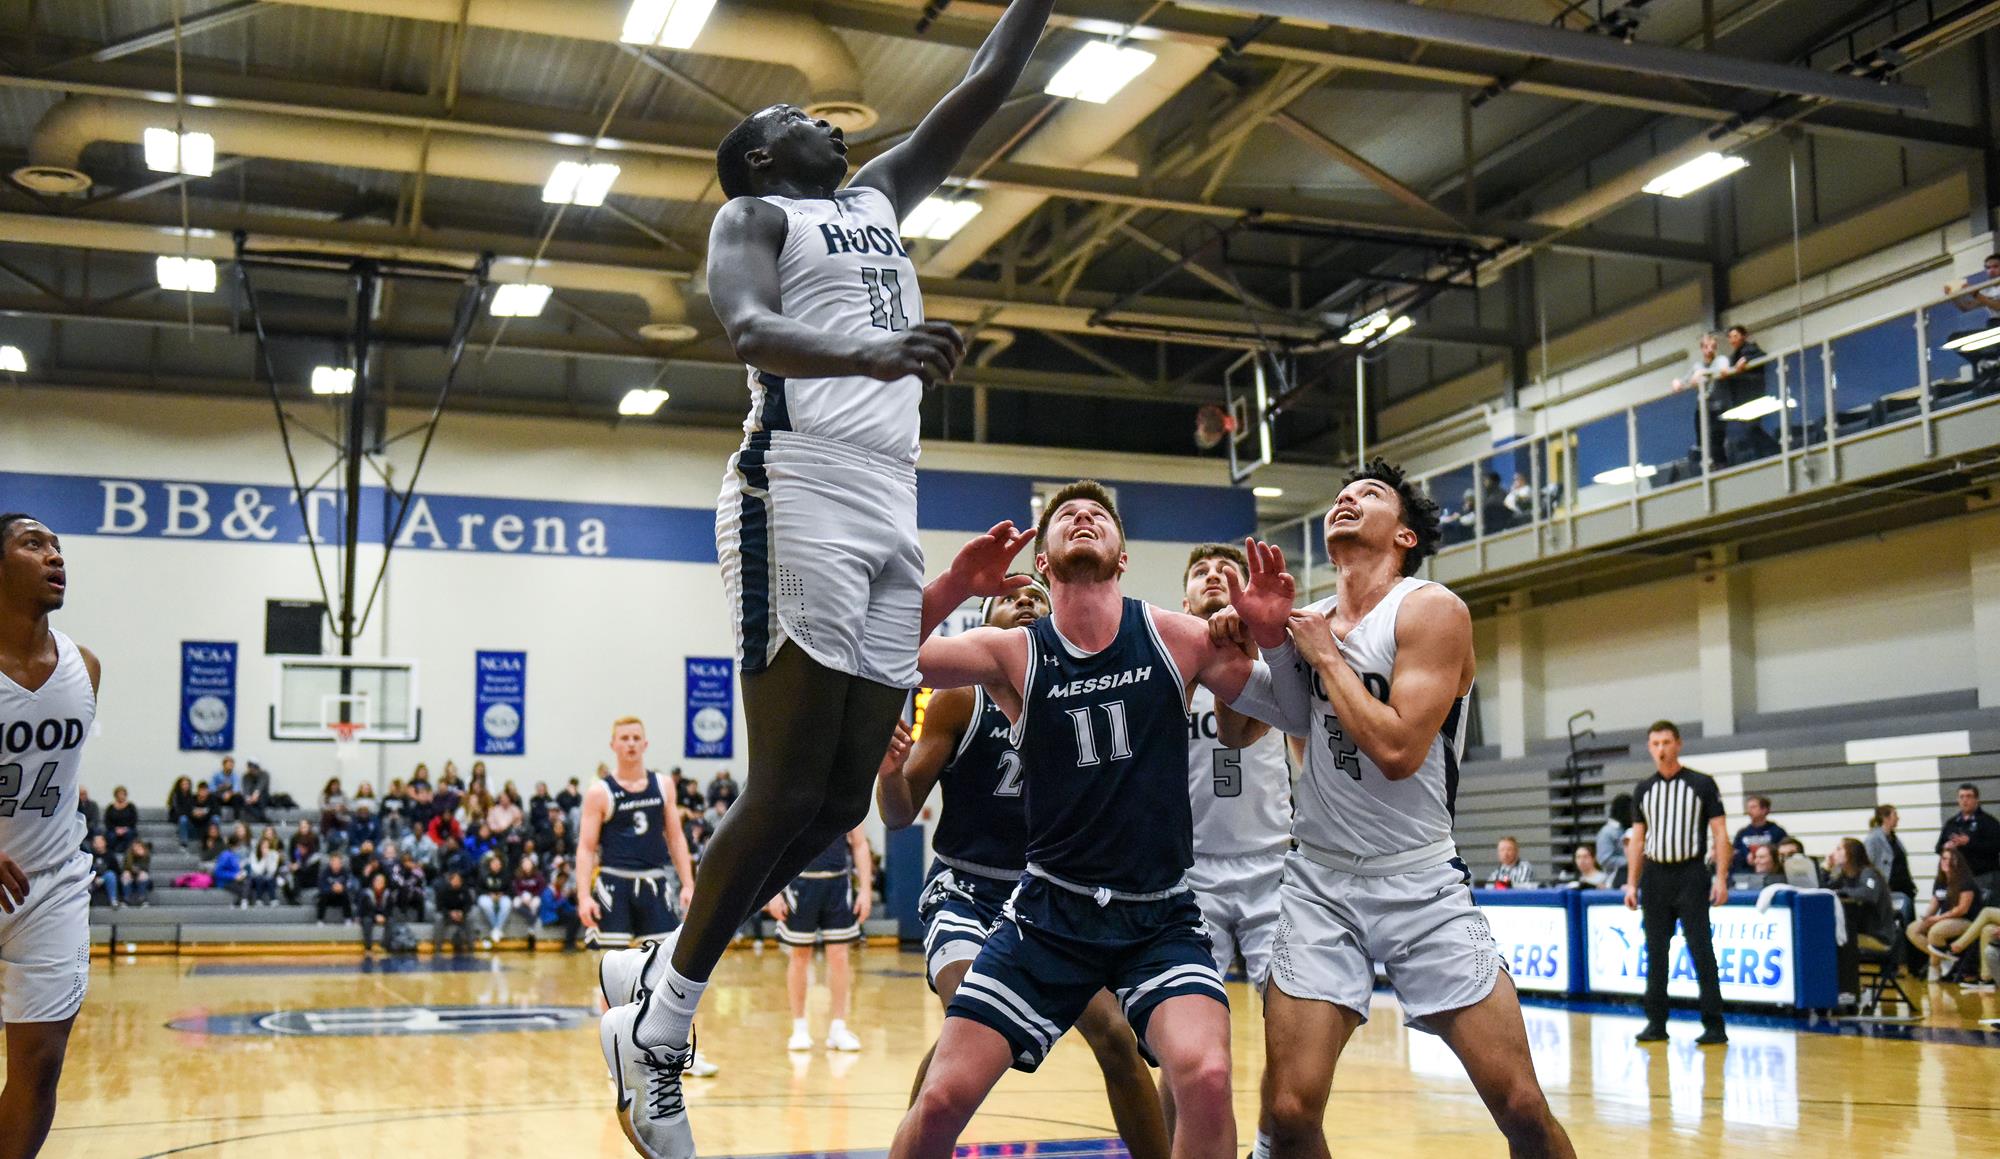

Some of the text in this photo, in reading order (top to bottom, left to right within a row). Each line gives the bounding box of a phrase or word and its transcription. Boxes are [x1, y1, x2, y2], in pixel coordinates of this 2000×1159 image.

[861, 266, 909, 332] 11
[96, 480, 609, 556] BB&T Arena
[187, 647, 232, 662] NCAA
[480, 657, 521, 671] NCAA
[689, 663, 729, 677] NCAA
[1046, 666, 1152, 699] MESSIAH
[1064, 700, 1133, 768] 11
[1323, 714, 1362, 781] 2
[0, 761, 61, 818] 24
[1213, 747, 1242, 798] 5
[632, 810, 649, 835] 3
[1711, 923, 1778, 940] LLEGE
[1636, 943, 1784, 987] BAERS
